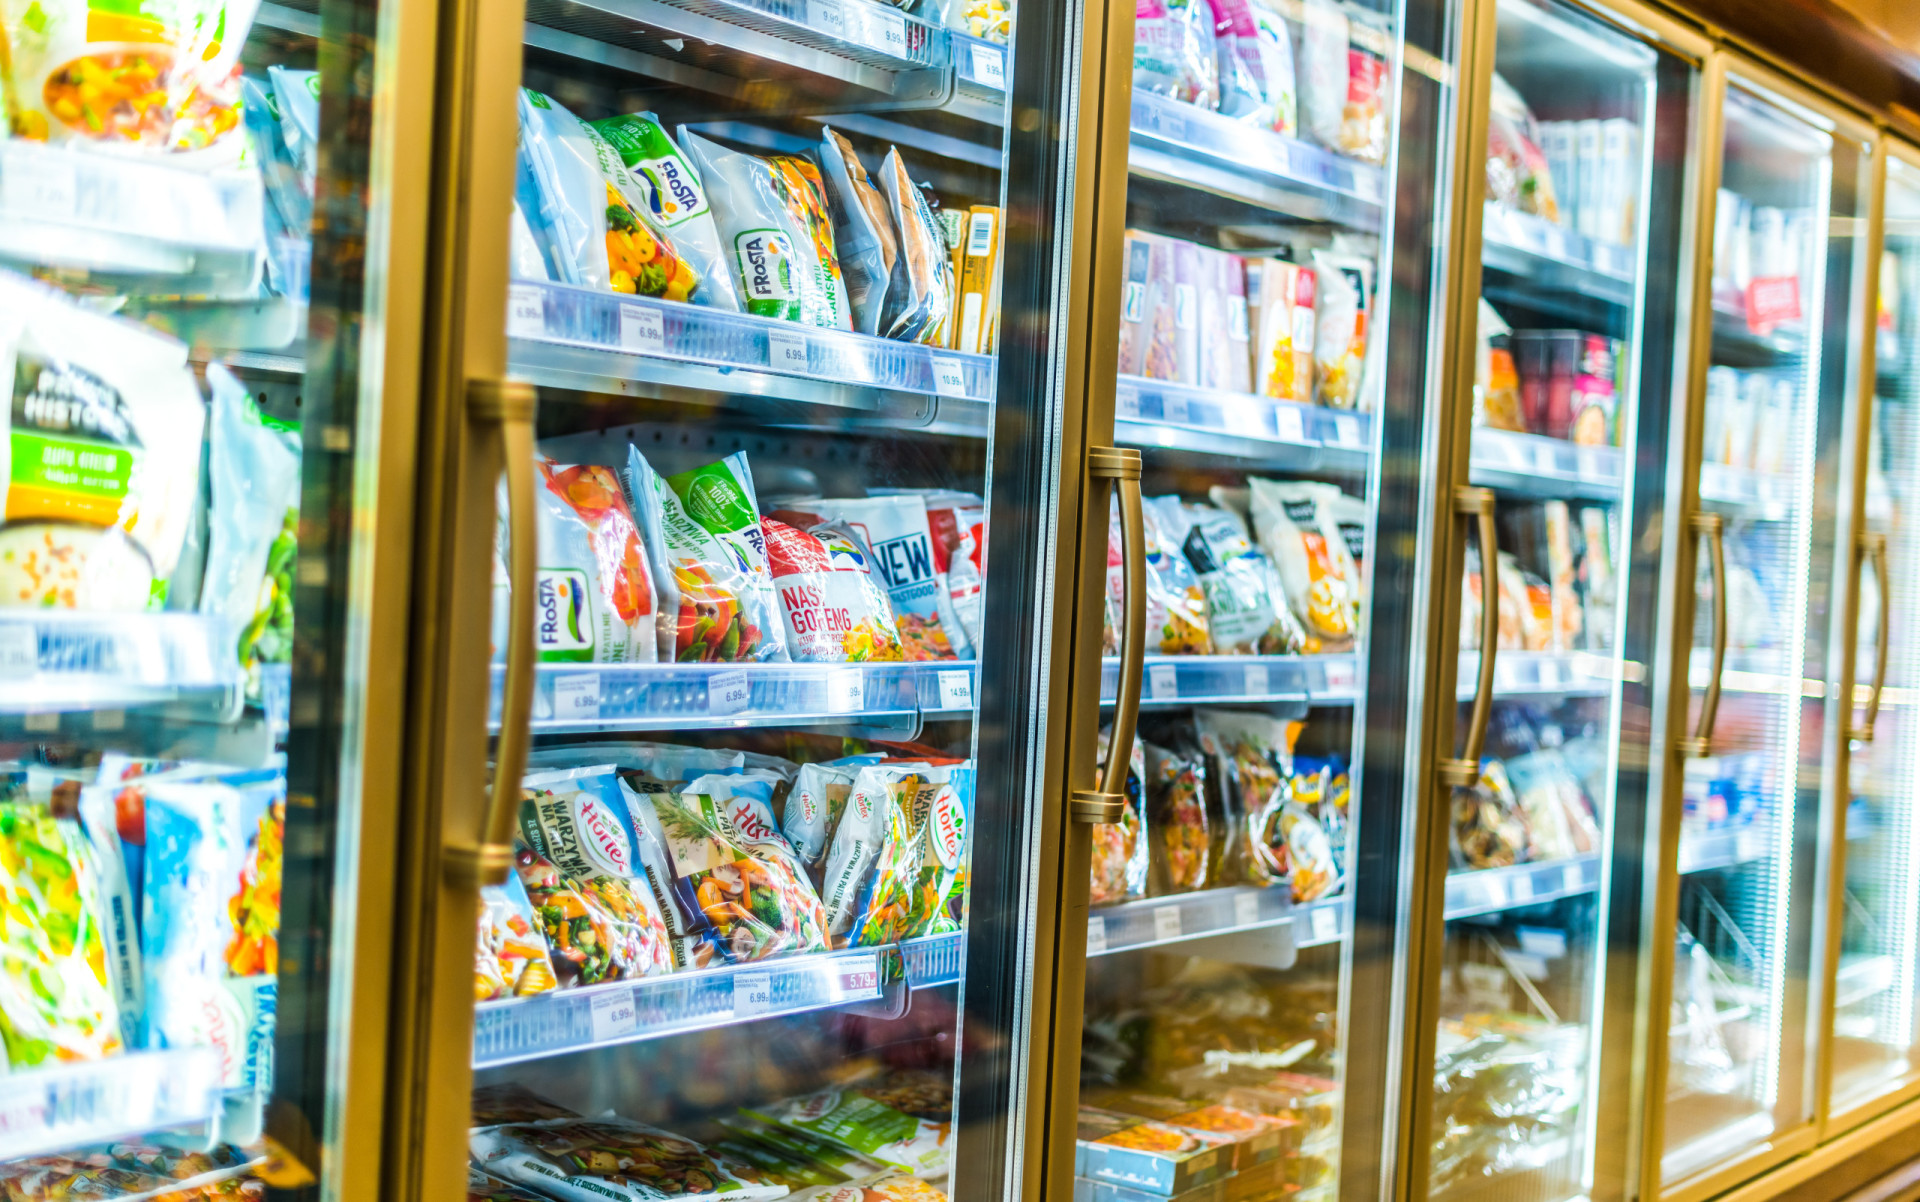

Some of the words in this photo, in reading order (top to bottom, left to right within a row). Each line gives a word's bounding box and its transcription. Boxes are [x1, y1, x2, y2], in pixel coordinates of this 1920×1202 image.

[708, 485, 731, 509] 100%
[540, 803, 556, 823] NA
[801, 793, 812, 821] Hortex
[855, 792, 869, 819] Hortex
[553, 799, 593, 876] WARZYWA
[580, 799, 628, 873] Hortex
[935, 793, 957, 863] Hortex
[846, 839, 864, 870] WARZYWA
[646, 864, 663, 900] WARZYWA
[659, 899, 668, 910] NA
[841, 869, 852, 880] NA
